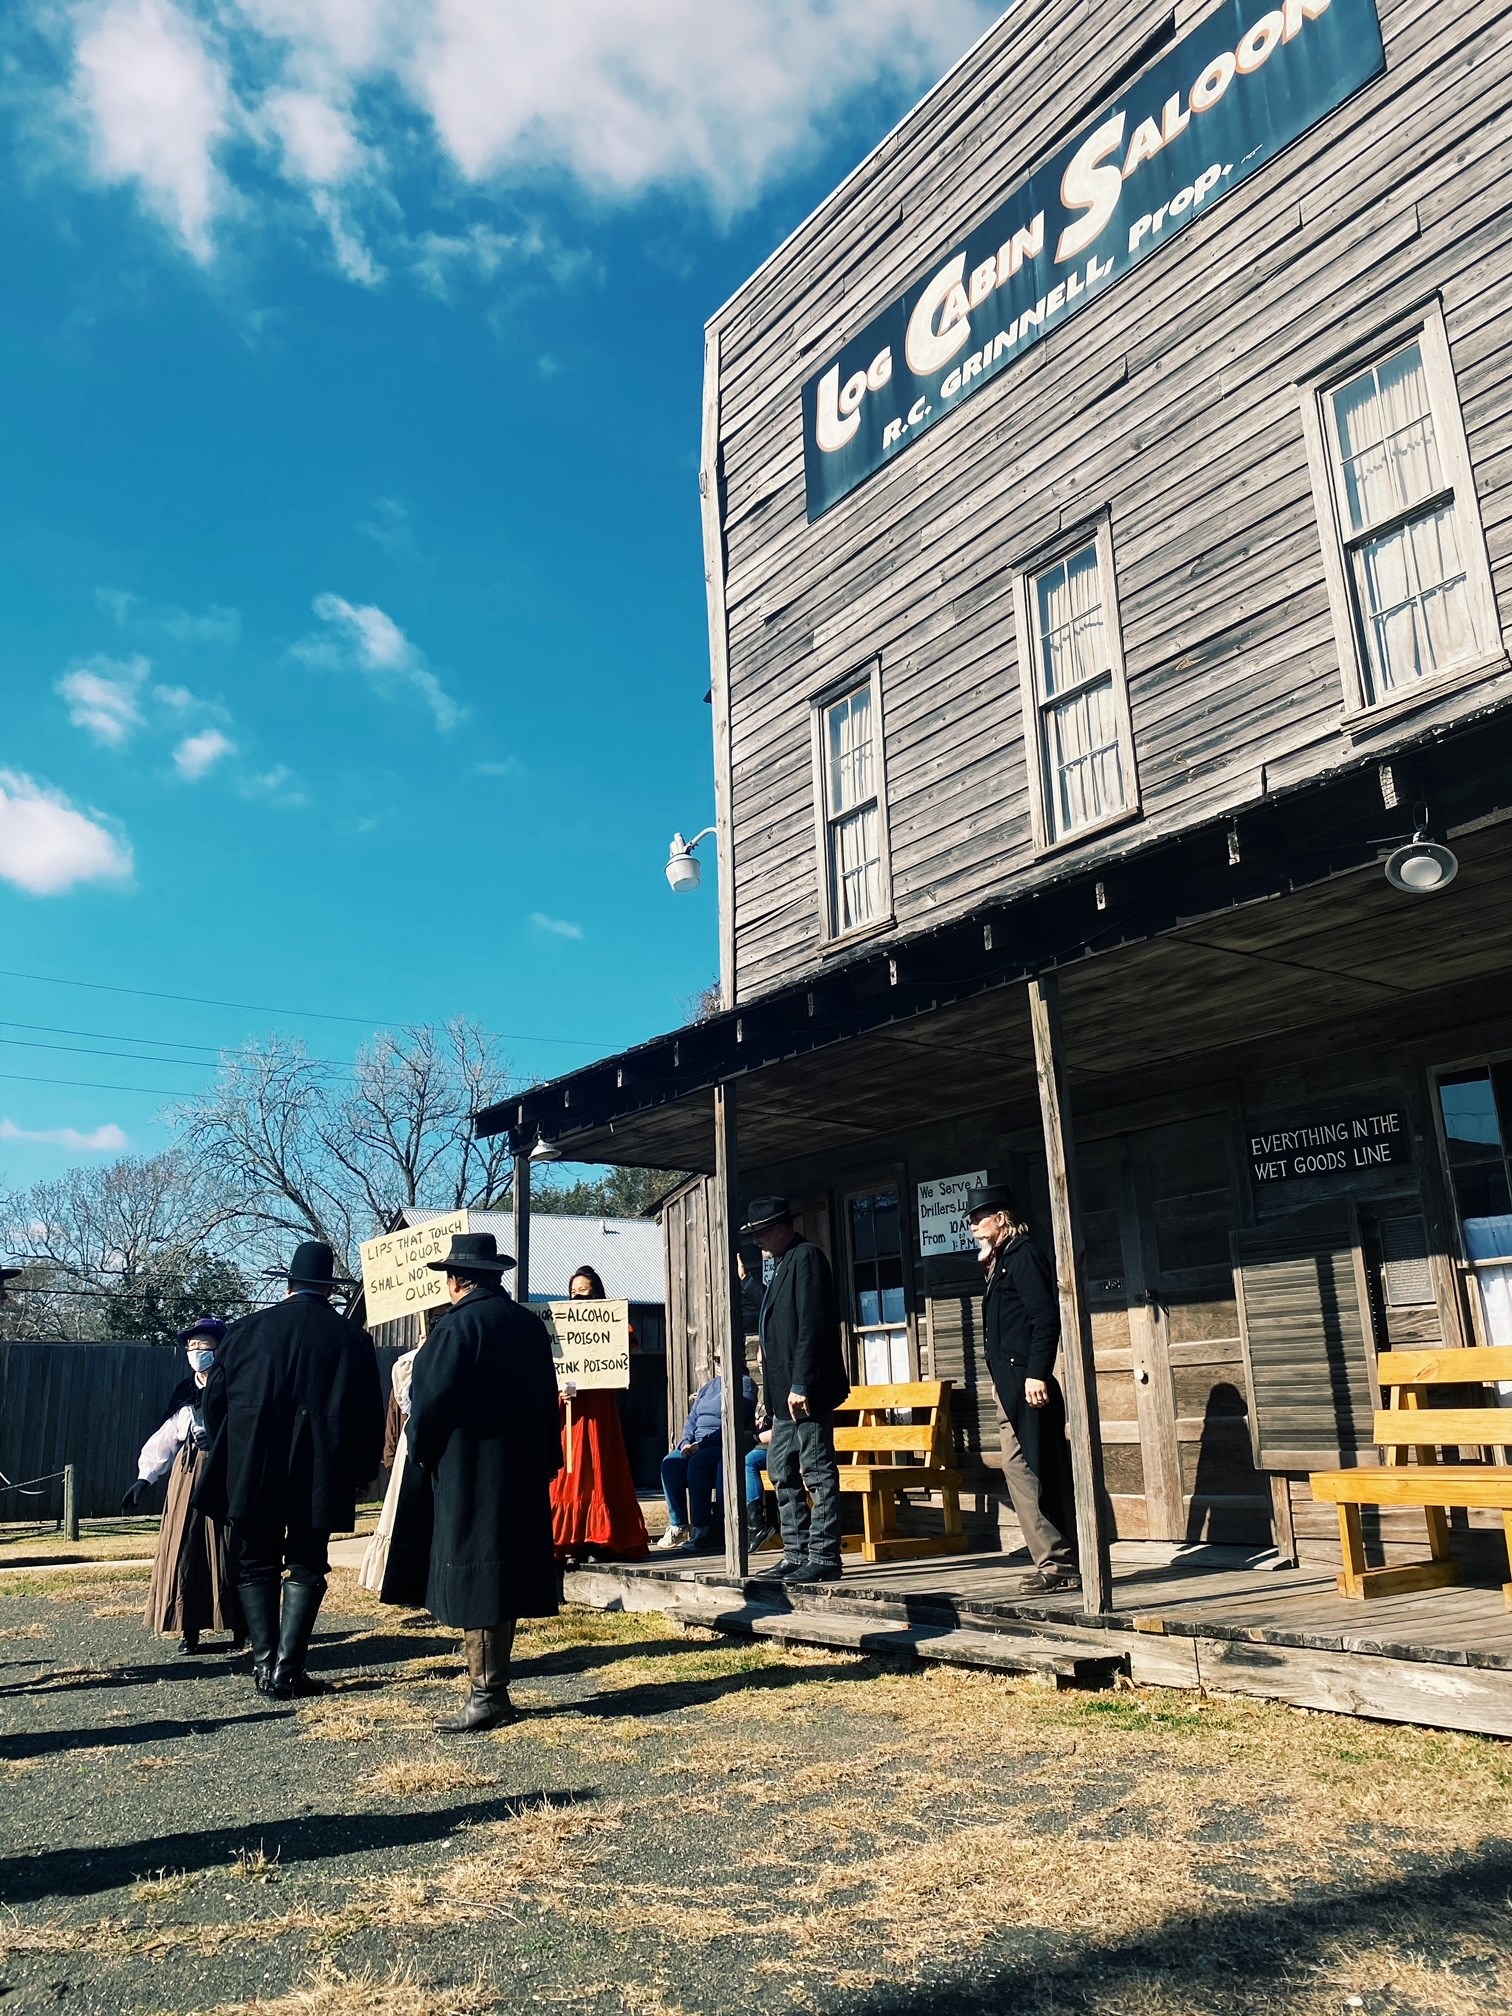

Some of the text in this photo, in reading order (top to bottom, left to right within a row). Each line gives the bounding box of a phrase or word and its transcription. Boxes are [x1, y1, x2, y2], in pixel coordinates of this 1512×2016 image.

[882, 163, 1235, 450] R.C. GRINNELL, Prop.
[816, 346, 892, 452] LOG
[905, 209, 1044, 376] CABIN
[1251, 1113, 1400, 1155] EVERYTHING IN THE
[1254, 1143, 1392, 1181] WET GOODS LINE
[920, 1186, 934, 1198] We
[939, 1180, 971, 1196] Serve
[921, 1202, 956, 1218] Drillers
[367, 1219, 462, 1261] LIPS THAT TOUCH
[922, 1230, 946, 1246] From
[394, 1242, 442, 1267] LIQUOR
[370, 1265, 430, 1294] SHALL NOT
[405, 1279, 442, 1301] OURS
[554, 1353, 629, 1374] RINK POISON?
